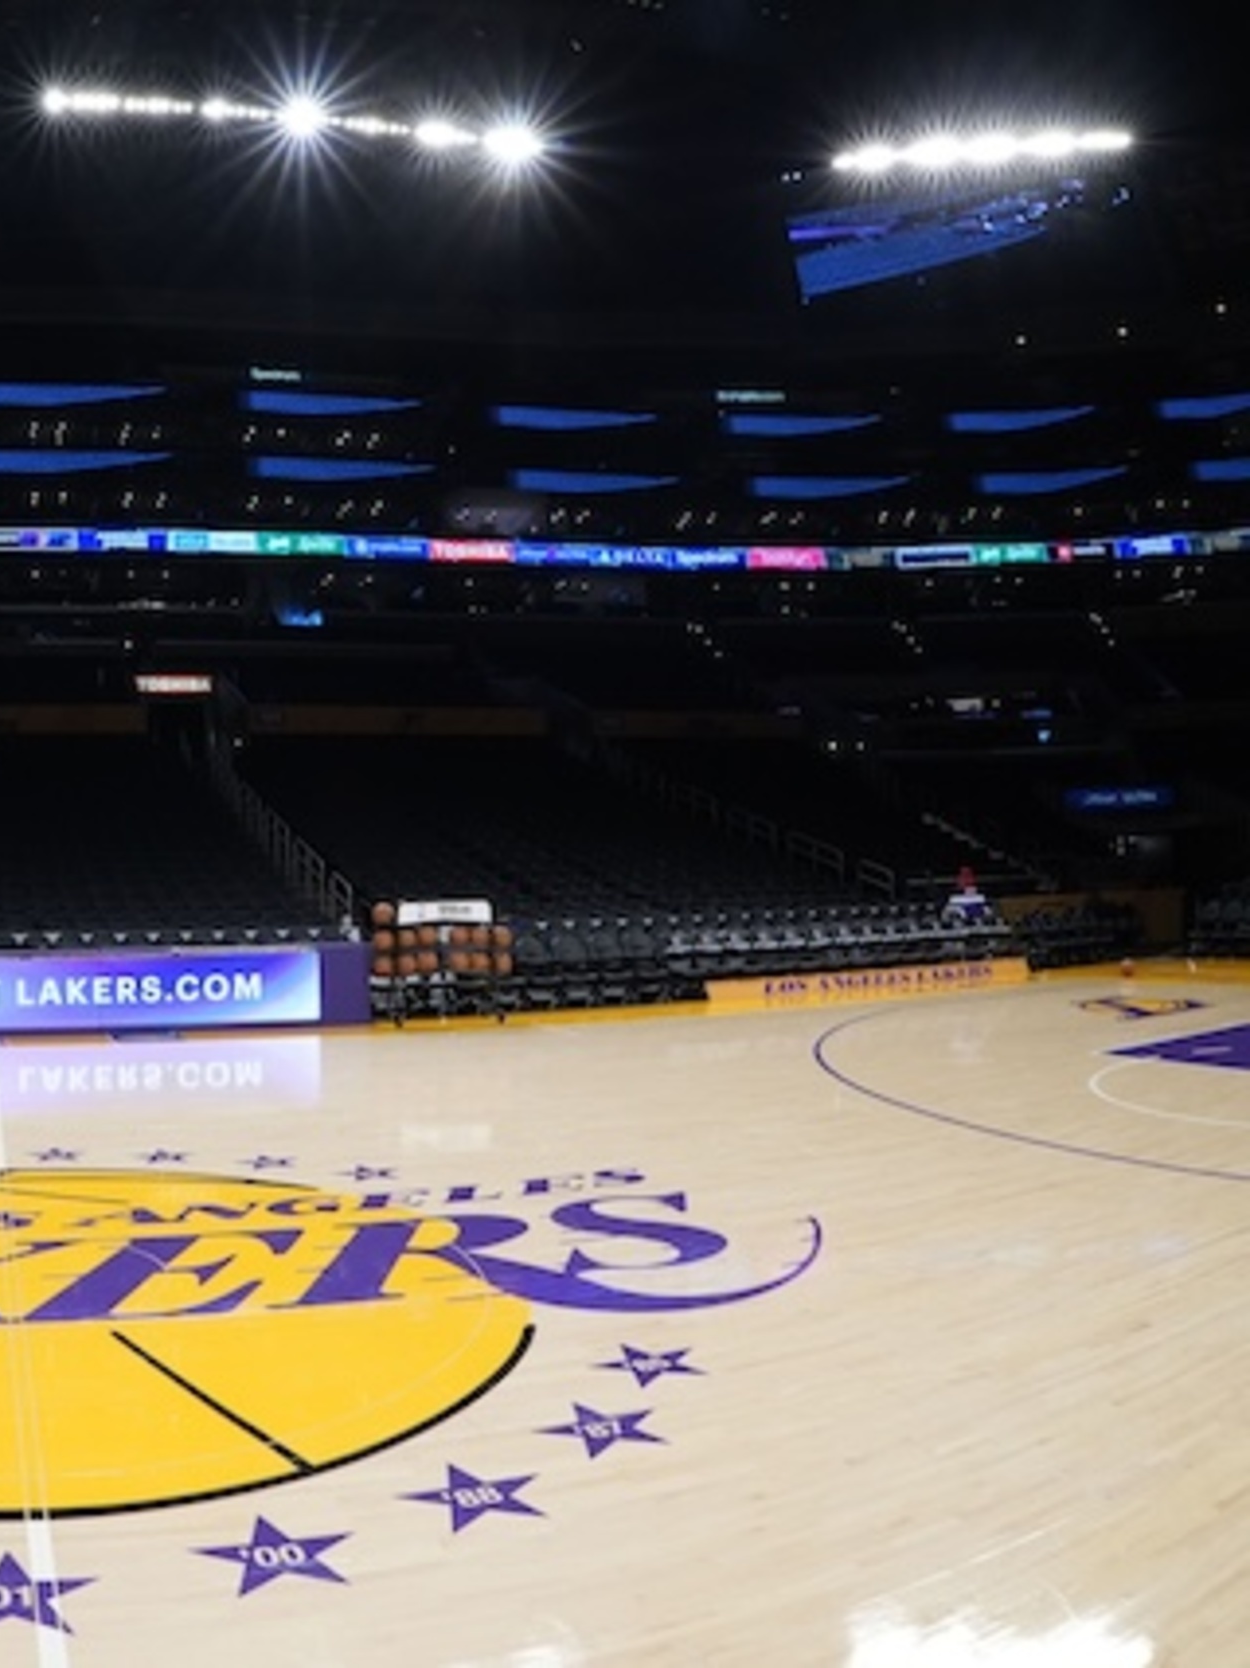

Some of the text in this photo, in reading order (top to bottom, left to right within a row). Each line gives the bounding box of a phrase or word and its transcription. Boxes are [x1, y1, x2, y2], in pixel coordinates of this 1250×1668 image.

[17, 973, 261, 1006] LAKERS.COM
[764, 979, 806, 995] LOS
[72, 1165, 648, 1227] ANGELES
[441, 1487, 503, 1508] '88
[238, 1544, 307, 1567] '00
